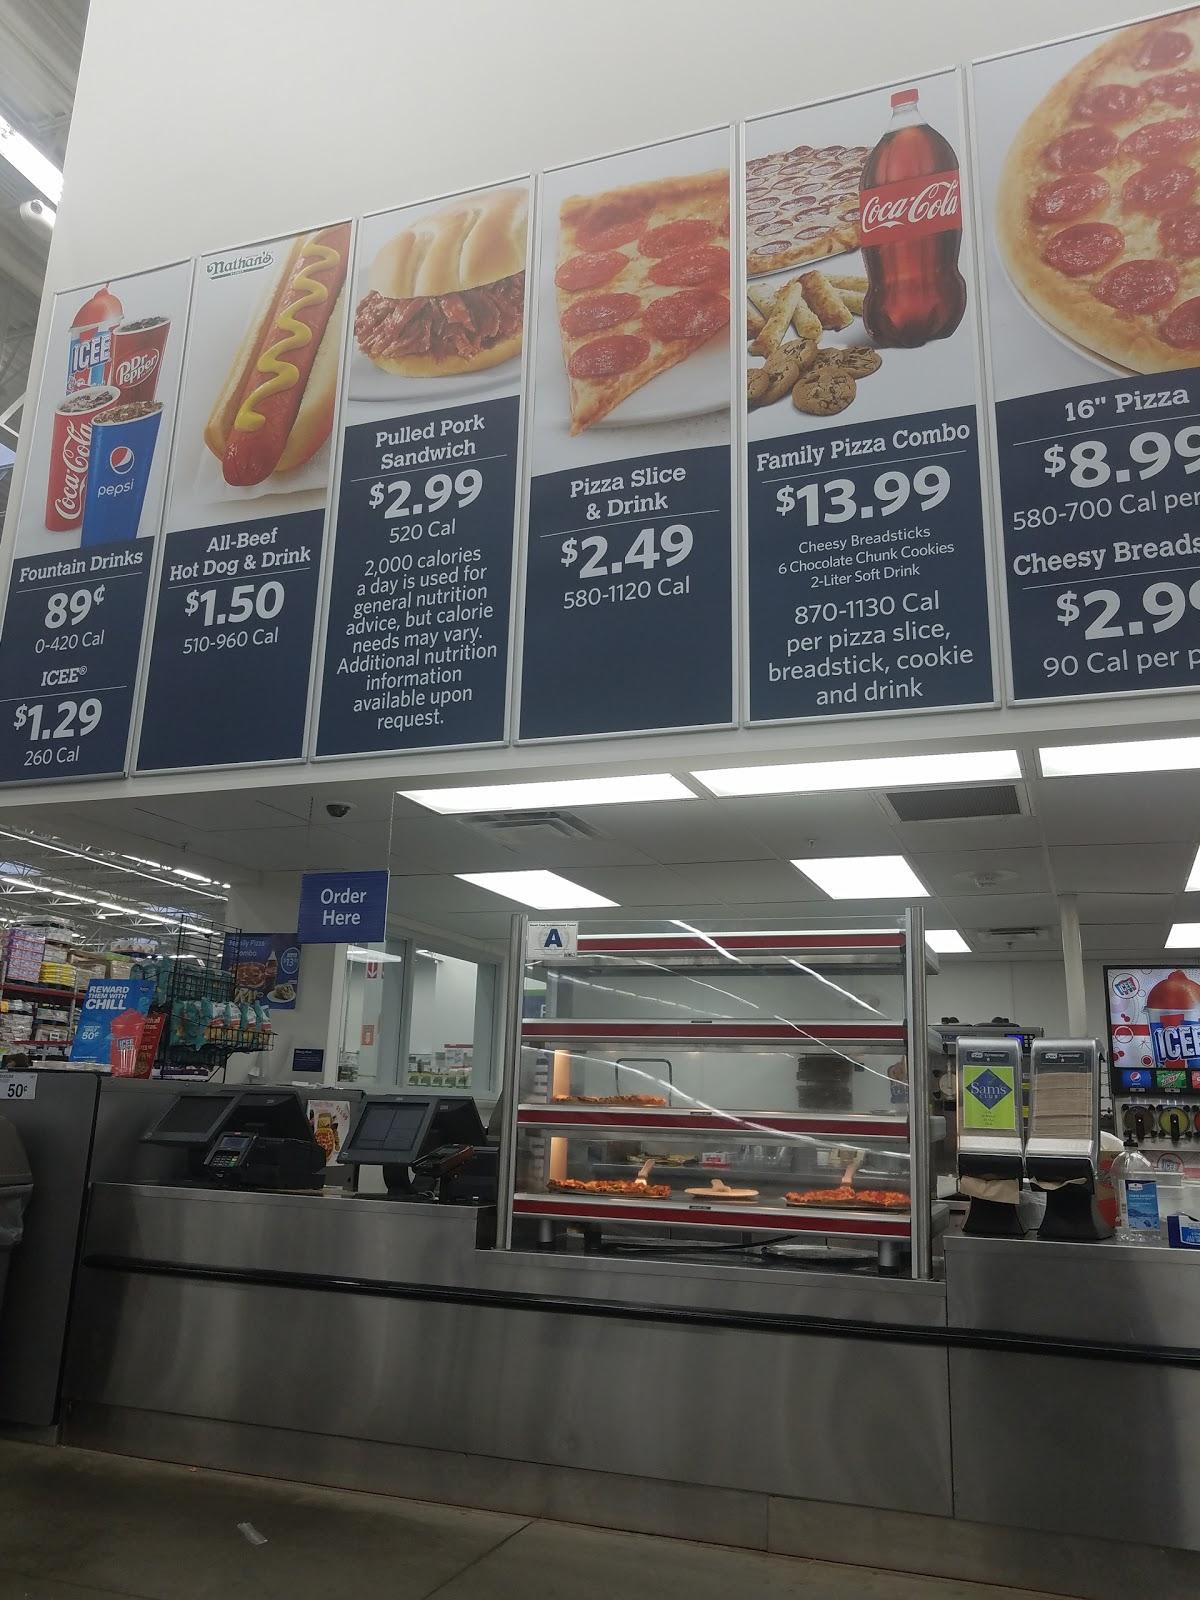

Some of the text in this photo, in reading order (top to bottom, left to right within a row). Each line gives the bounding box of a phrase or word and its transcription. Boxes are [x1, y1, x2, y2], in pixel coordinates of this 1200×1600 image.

[207, 251, 273, 275] Nathan's
[72, 336, 111, 373] ICEE
[131, 354, 148, 370] Dr
[118, 355, 158, 385] Pepper
[1064, 388, 1190, 422] 16" Pizza
[376, 414, 485, 447] Pulled Pork
[381, 440, 476, 469] Sandwich
[757, 423, 970, 472] Family Pizza Combo
[98, 479, 135, 498] pepsi
[369, 469, 483, 519] $2.99
[570, 467, 686, 498] Pizza Slice
[776, 465, 950, 527] $13.99
[586, 492, 668, 520] & Drink
[1013, 498, 1112, 530] 580-700
[1119, 491, 1157, 514] Cal
[207, 527, 278, 553] All-Beef
[389, 518, 456, 543] 520 Cal
[799, 527, 931, 554] Cheesy Breadsticks
[170, 546, 311, 581] Hot Dog & Drink
[364, 548, 481, 577] 2,000 calories
[561, 524, 693, 579] $2.49
[778, 543, 955, 574] 6 Chocolate Chunk Cookies
[1014, 549, 1106, 575] Cheesy
[19, 551, 143, 583] Fountain Drinks
[357, 565, 487, 596] a day is used for
[811, 564, 920, 588] 2-Liter Soft Drink
[44, 585, 106, 629] 89¢
[185, 581, 285, 626] $1.50
[353, 585, 487, 618] general nutrition
[563, 576, 690, 609] 580-1120 Cal
[794, 590, 939, 625] 870-1130 Cal
[346, 603, 494, 635] advice, but calorie
[1057, 578, 1200, 640] $2.9
[35, 630, 104, 654] 0-420 Cal
[183, 627, 278, 654] 510-960 Cal
[353, 627, 482, 653] needs may vary.
[787, 621, 950, 656] per pizza slice,
[336, 643, 497, 674] Additional nutrition
[768, 645, 974, 682] breadstick, cookie
[1043, 656, 1078, 678] 90
[1086, 650, 1128, 674] Cal
[1137, 650, 1179, 674] per
[366, 667, 462, 691] information
[816, 677, 924, 705] and drink
[353, 688, 472, 712] available upon
[14, 698, 102, 741] $1.29
[377, 709, 444, 731] request.
[24, 746, 79, 766] 260 Cal
[321, 888, 366, 904] Order
[323, 910, 360, 925] Here
[544, 929, 562, 947] A
[86, 999, 126, 1010] CHILL
